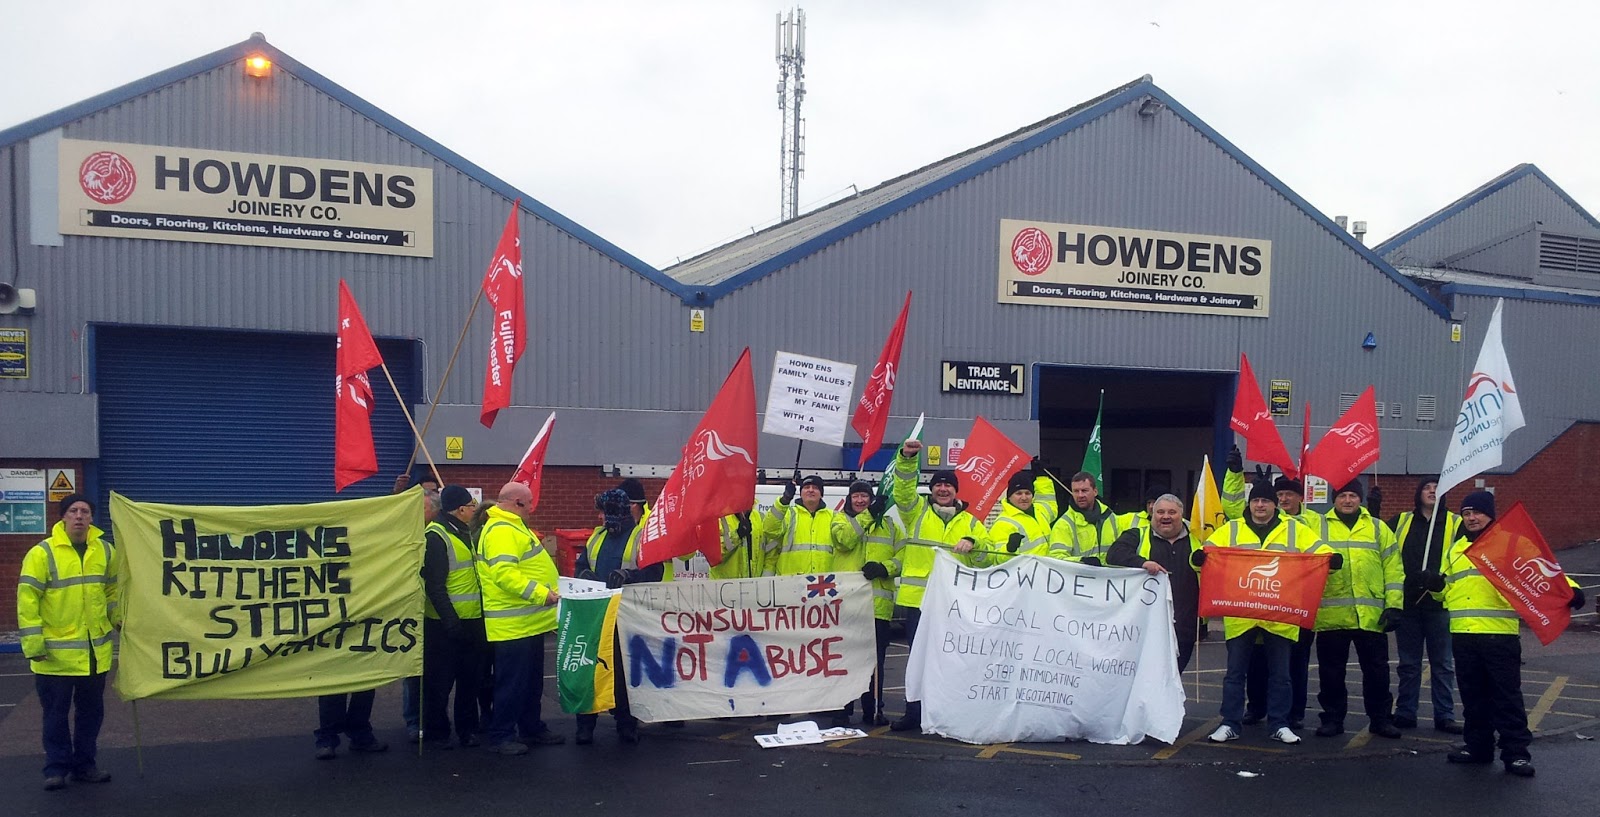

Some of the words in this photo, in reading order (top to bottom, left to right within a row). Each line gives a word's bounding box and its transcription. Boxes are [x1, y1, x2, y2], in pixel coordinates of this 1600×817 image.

[154, 155, 416, 209] HOWDENS
[227, 199, 305, 219] JOINERY
[309, 205, 340, 221] CO.
[110, 214, 152, 227] Doors,
[156, 217, 209, 231] Flooring,
[212, 221, 269, 236] Kitchens,
[272, 225, 331, 239] Hardware
[333, 229, 343, 239] &
[346, 230, 389, 243] Joinery
[1057, 231, 1262, 276] HOWDENS
[1117, 271, 1179, 287] JOINERY
[1181, 275, 1206, 289] CO.
[1032, 285, 1064, 296] Doors,
[1067, 287, 1108, 299] Flooring,
[1110, 290, 1153, 301] Kitchens,
[1155, 292, 1198, 303] Hardware
[1200, 295, 1207, 303] &
[1209, 296, 1242, 307] Joinery
[499, 309, 515, 364] Fujitsu
[778, 367, 808, 379] FAMILY
[957, 378, 1010, 391] ENTRANCE
[967, 366, 1000, 378] TRADE
[787, 386, 809, 396] THEY
[813, 391, 840, 402] VALUE
[794, 398, 807, 406] MY
[811, 401, 841, 412] FAMILY
[783, 411, 805, 421] WITH
[799, 424, 815, 433] P45
[160, 517, 352, 561] HOWDENS
[162, 560, 351, 601] KITCHENS
[953, 561, 1160, 606] HOWDENS
[1238, 576, 1282, 592] unite
[1512, 556, 1551, 594] unite
[632, 579, 787, 612] MEANINGFUL
[1211, 599, 1309, 617] www.unitetheunion.org
[204, 597, 348, 639] STOP!
[947, 599, 962, 619] A
[973, 604, 1041, 630] LOCAL
[1053, 614, 1141, 643] COMPANY
[161, 641, 285, 681] BULLY
[567, 634, 588, 673] unite
[627, 633, 714, 689] NOT
[724, 634, 848, 688] ABUSE
[942, 631, 1024, 661] BULLYING
[1033, 644, 1083, 670] LOCAL
[983, 663, 1015, 681] STOP
[1019, 667, 1081, 689] INTIMIDATING
[967, 684, 1010, 701] START
[1015, 687, 1074, 706] NEGOTIATING
